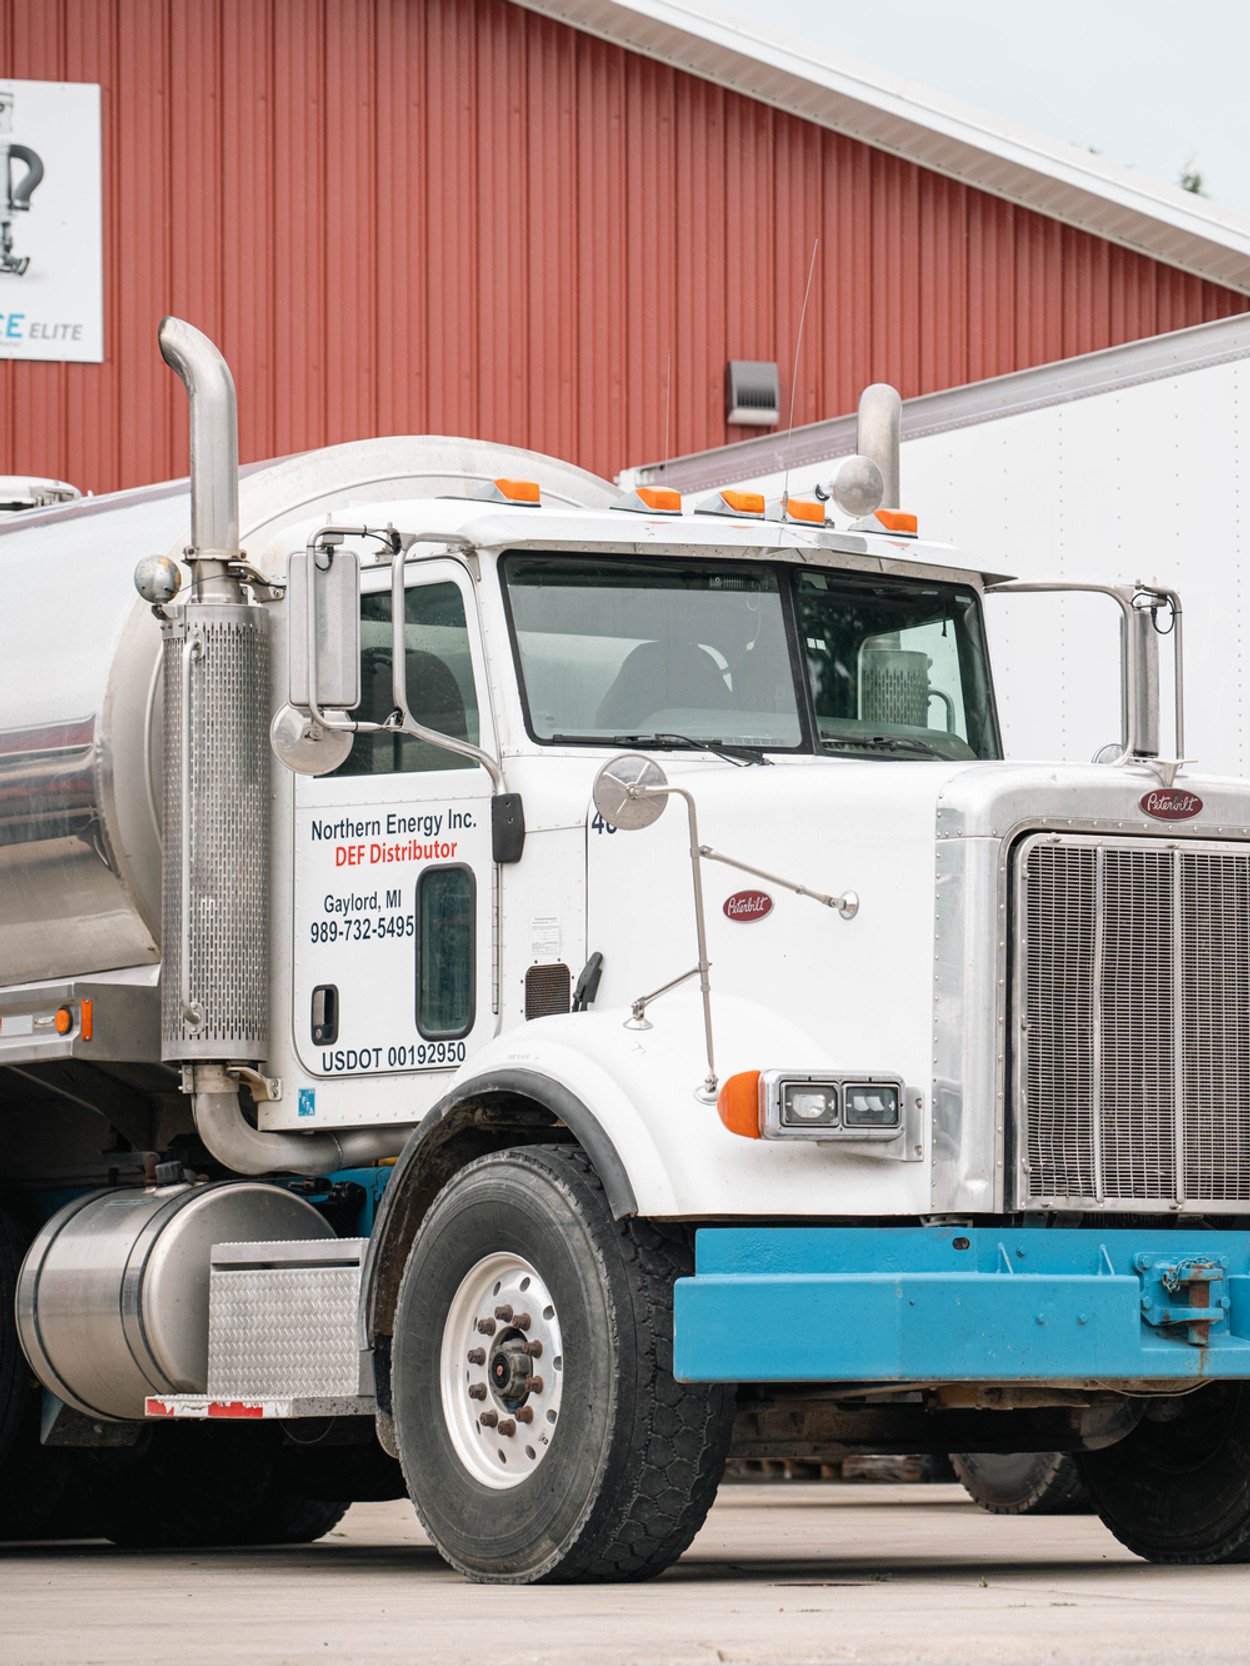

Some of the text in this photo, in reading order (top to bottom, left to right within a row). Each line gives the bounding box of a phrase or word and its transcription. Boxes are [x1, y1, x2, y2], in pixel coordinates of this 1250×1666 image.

[29, 322, 83, 341] ELITE
[1147, 793, 1198, 811] Peterbilt
[311, 808, 477, 841] Northern Energy Inc.
[335, 839, 458, 867] DEF Distributor
[323, 888, 402, 917] Gaylord, MI
[728, 896, 768, 916] Peterbilt
[310, 914, 415, 944] 989-732-5495
[322, 1041, 466, 1073] USDOT 00192950
